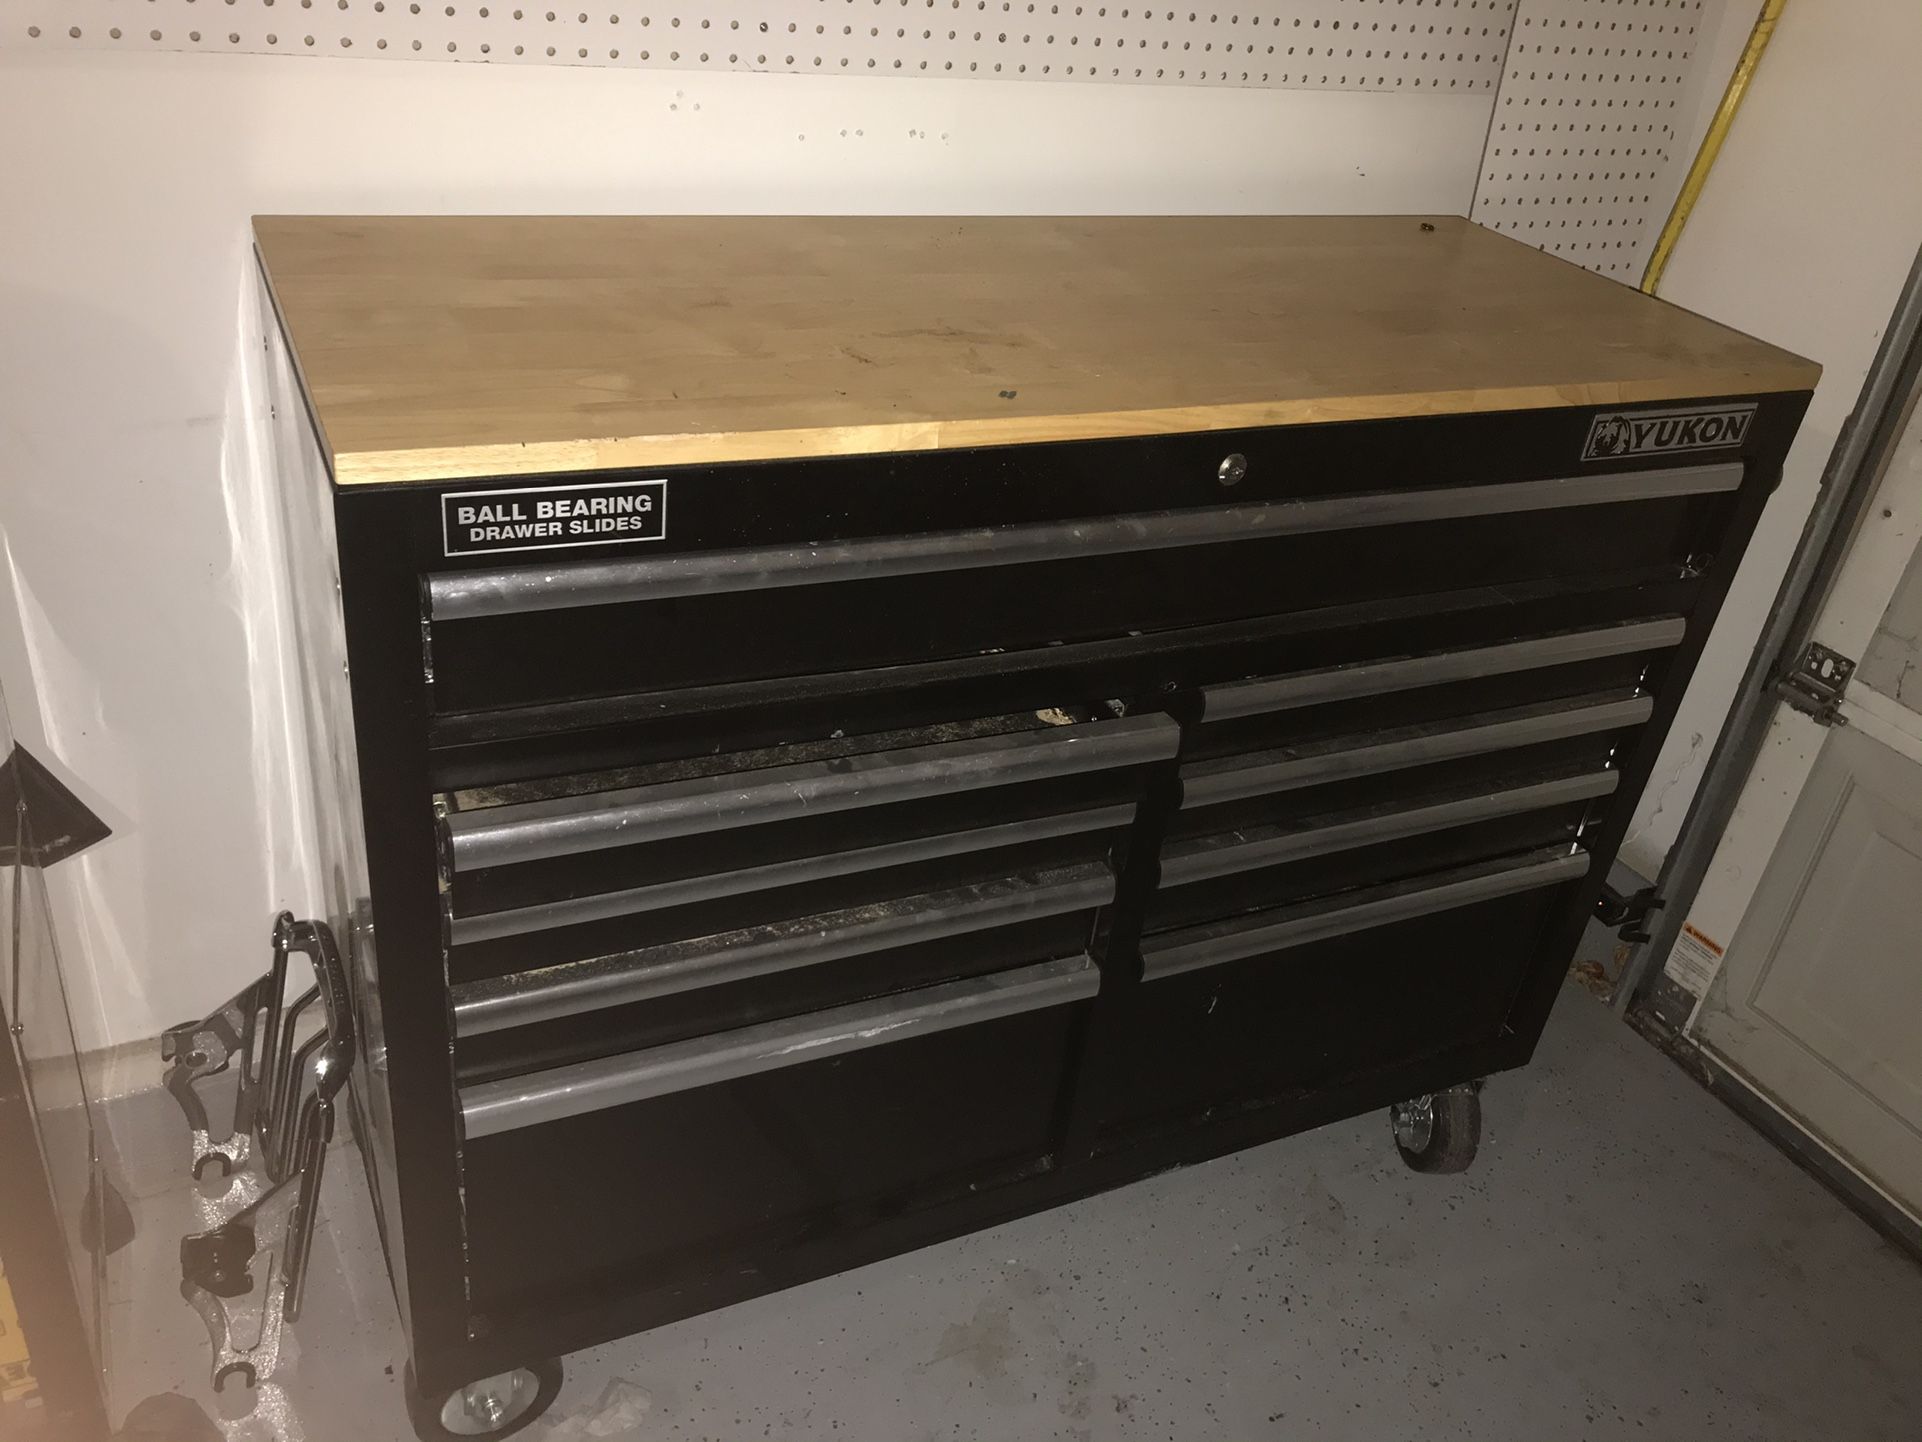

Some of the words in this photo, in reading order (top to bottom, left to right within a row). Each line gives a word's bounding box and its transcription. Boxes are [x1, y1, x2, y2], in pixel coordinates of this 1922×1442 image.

[1632, 415, 1749, 449] YUKON
[458, 503, 527, 525] BALL
[536, 494, 652, 519] BEARING
[470, 521, 563, 542] DRAWER
[569, 516, 642, 534] SLIDES
[1692, 929, 1722, 953] WARNING
